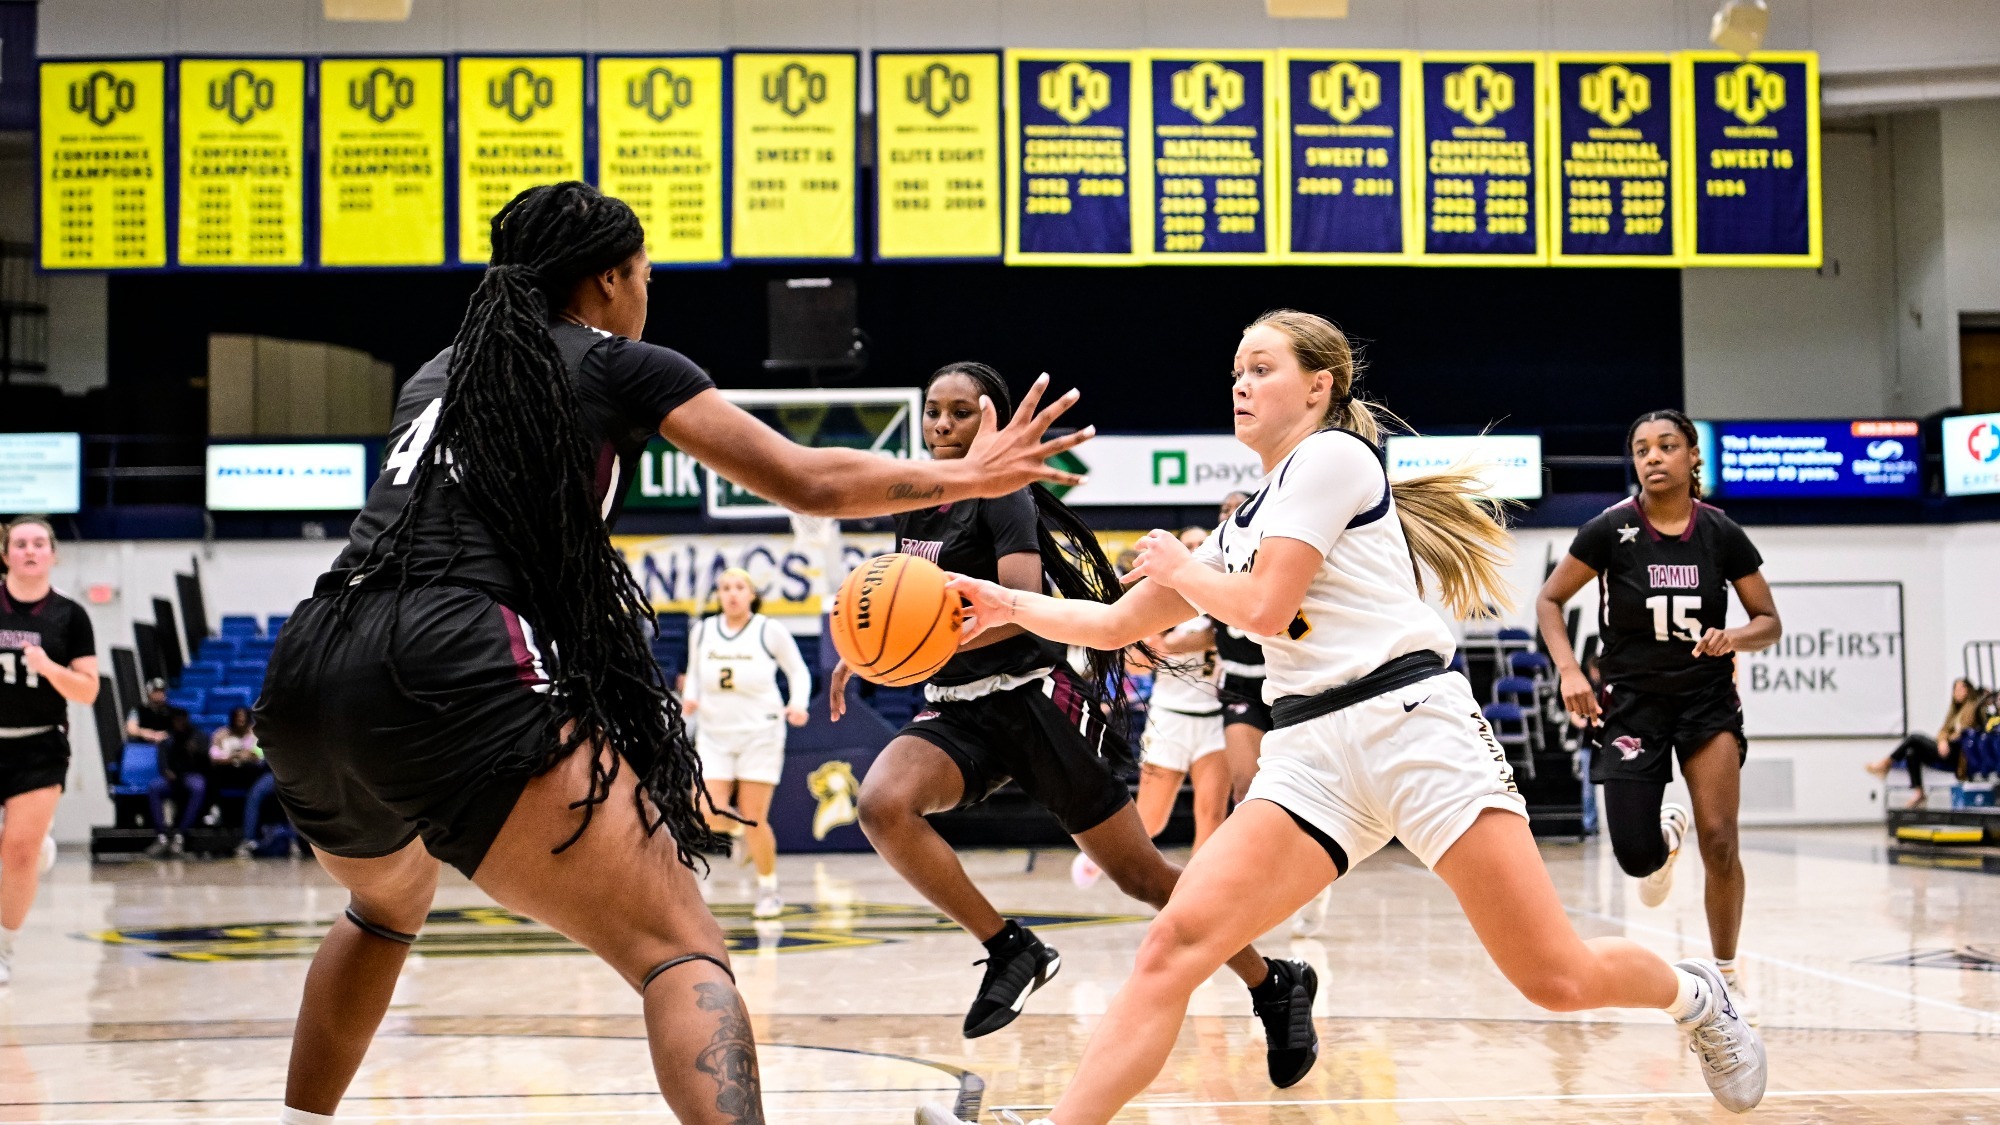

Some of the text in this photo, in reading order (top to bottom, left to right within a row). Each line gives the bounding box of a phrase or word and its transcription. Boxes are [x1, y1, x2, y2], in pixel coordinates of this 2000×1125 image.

[68, 70, 136, 126] UCO
[208, 69, 274, 125] UCO
[349, 67, 414, 123] UCO
[488, 67, 553, 122] UCO
[627, 67, 693, 122] UCO
[763, 63, 826, 117] UCO
[906, 63, 969, 117] UCO
[1038, 62, 1110, 124] UCO
[1171, 62, 1244, 124] UCO
[1310, 61, 1381, 123] UCO
[1443, 64, 1515, 125] UCO
[1579, 64, 1651, 127] UCO
[1714, 63, 1786, 124] UCO
[756, 148, 835, 163] SWEET 16
[891, 149, 984, 164] ELITE EIGHT
[1025, 140, 1124, 156] CONFERENCE
[1164, 140, 1254, 158] NATIONAL
[1305, 148, 1388, 168] SWEET 16
[1431, 140, 1527, 156] CONFERENCE
[1571, 142, 1660, 160] NATIONAL
[1710, 149, 1793, 169] SWEET 16
[52, 167, 152, 179] CHAMPIONS
[1023, 155, 1126, 174] CHAMPIONS
[1157, 158, 1261, 175] TOURNAMENT
[1429, 155, 1531, 176] CHAMPIONS
[1564, 159, 1669, 177] TOURNAMENT
[1647, 564, 1700, 589] TAMIU
[1645, 595, 1702, 643] 15
[719, 666, 735, 691] 2
[1752, 664, 1839, 692] BANK
